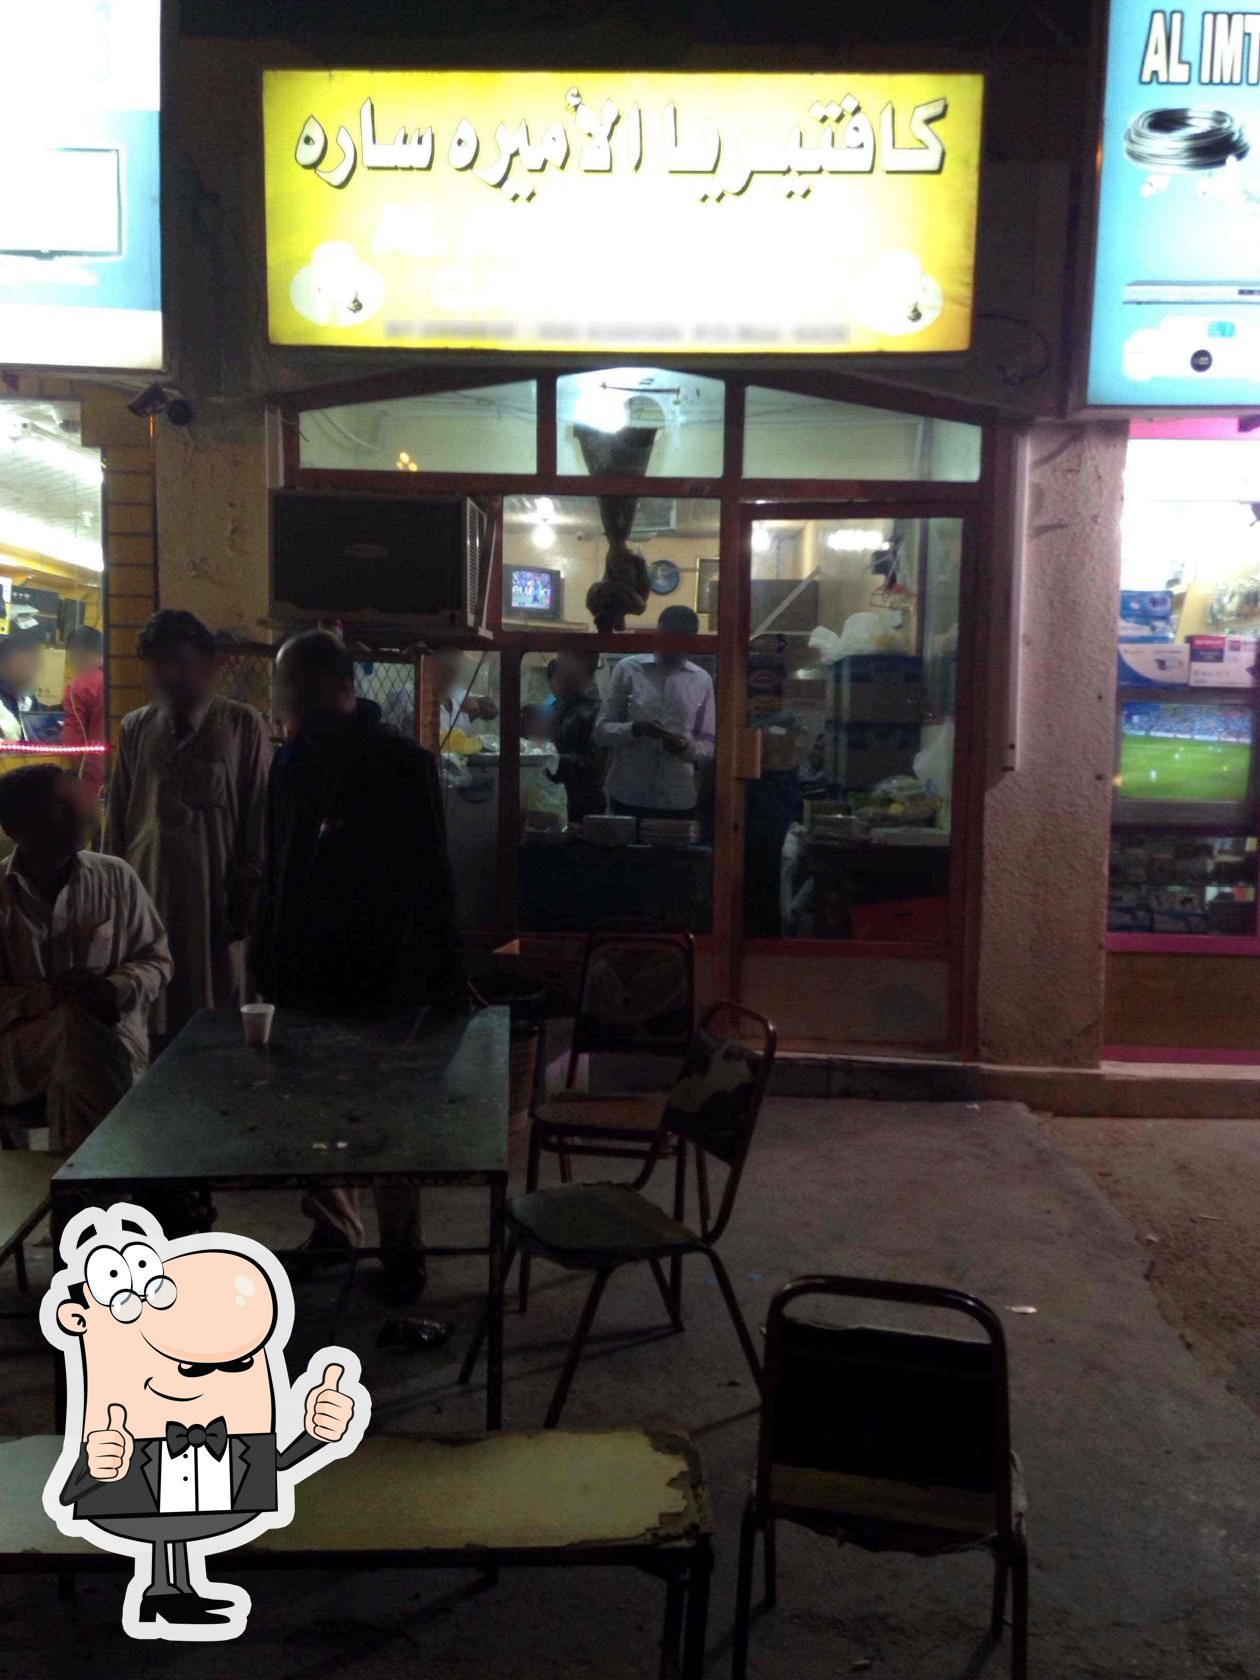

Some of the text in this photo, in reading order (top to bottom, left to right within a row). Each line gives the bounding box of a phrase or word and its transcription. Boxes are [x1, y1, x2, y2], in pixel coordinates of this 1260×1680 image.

[1139, 10, 1192, 85] AL
[295, 96, 435, 190] ساره
[662, 92, 948, 203] كافتيريا
